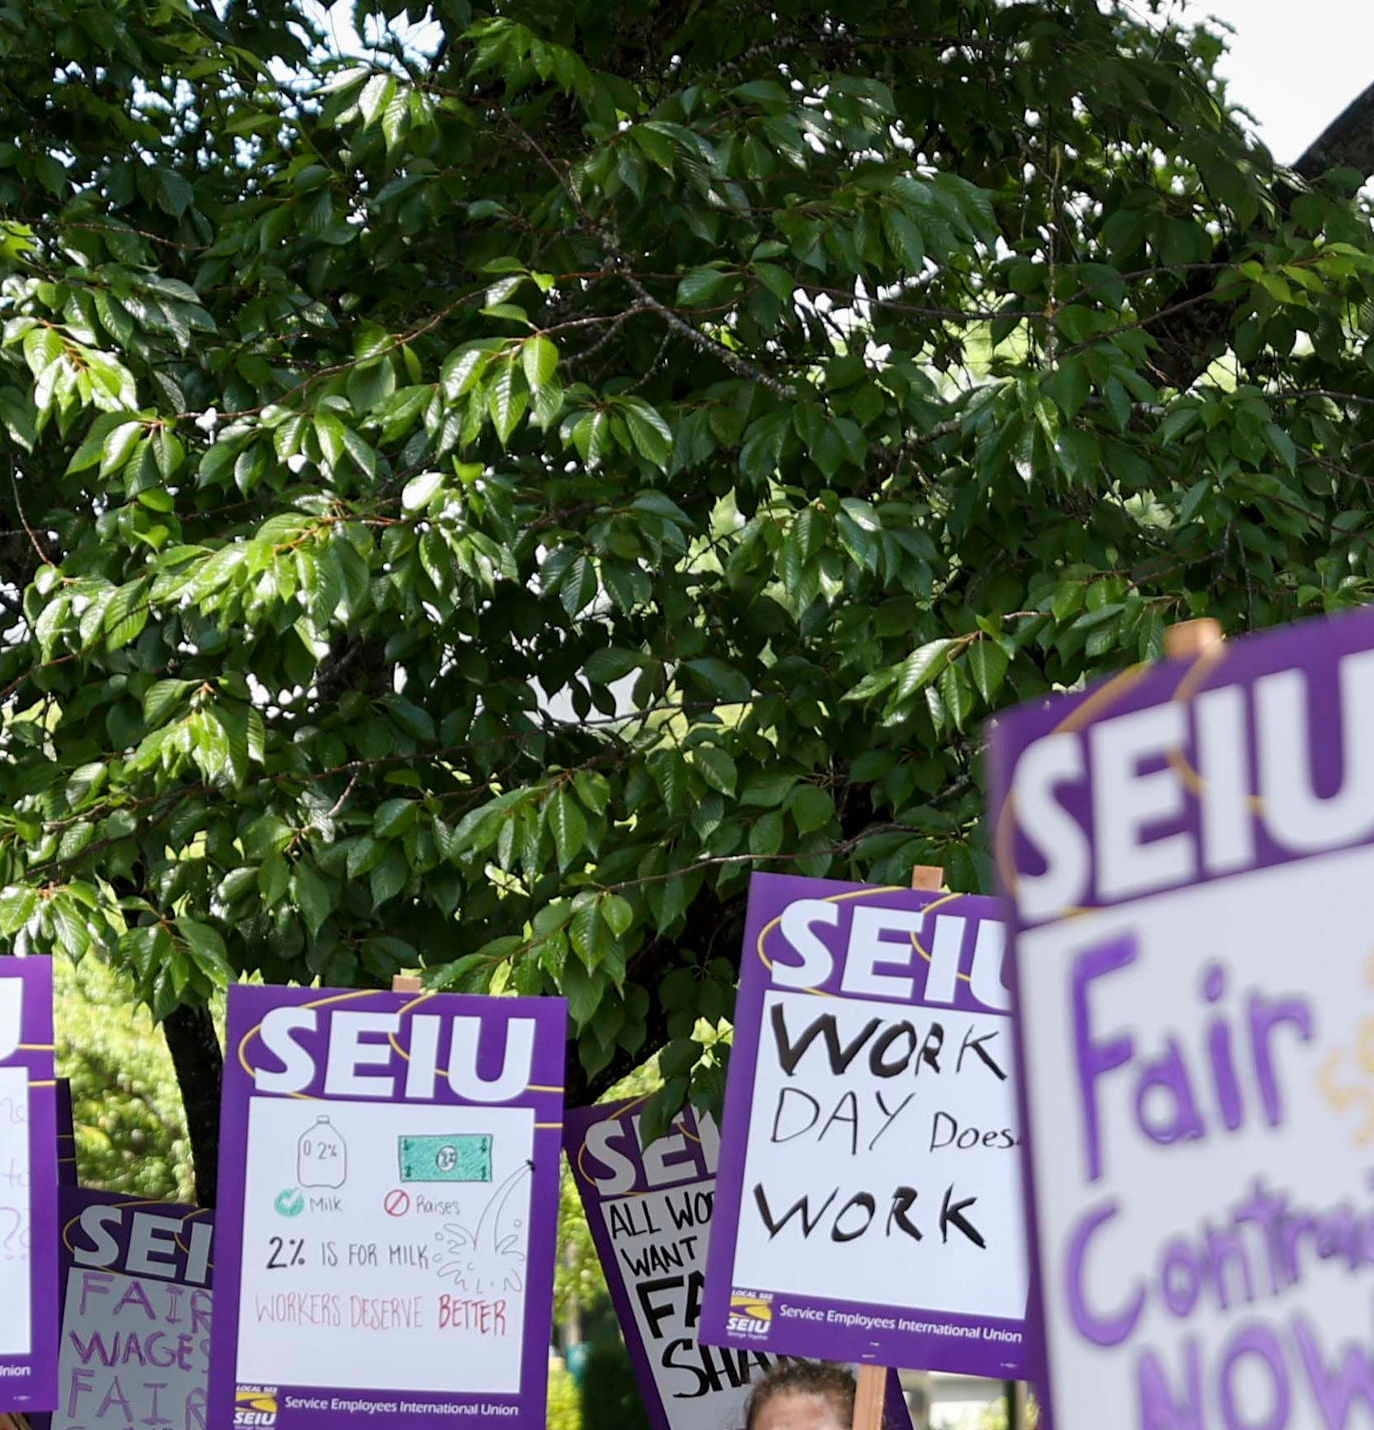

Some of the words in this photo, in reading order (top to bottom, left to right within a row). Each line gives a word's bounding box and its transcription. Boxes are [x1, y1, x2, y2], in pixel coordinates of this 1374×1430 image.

[255, 1006, 537, 1102] SEIU
[770, 1002, 1007, 1080] WORK
[1071, 930, 1314, 1183] Fair
[771, 1086, 915, 1156] DAY
[930, 1110, 1021, 1152] Does
[585, 1104, 721, 1196] SEI
[416, 1194, 461, 1216] Raises
[609, 1200, 662, 1240] ALL
[753, 1182, 986, 1249] WORK
[74, 1204, 213, 1284] SEI
[266, 1236, 306, 1270] 2%
[321, 1241, 338, 1268] IS
[348, 1243, 378, 1267] FOR
[388, 1244, 430, 1270] MILK
[621, 1236, 699, 1278] WANT
[255, 1292, 341, 1328] WORKERS
[350, 1294, 424, 1331] DESERVE
[437, 1293, 506, 1337] BETTER
[726, 1318, 770, 1333] SEIU
[779, 1304, 825, 1320] Service
[826, 1310, 896, 1330] Employees
[898, 1317, 980, 1339] International
[982, 1328, 1022, 1344] Union
[233, 1412, 277, 1425] SEIU
[284, 1396, 327, 1410] Service
[330, 1398, 398, 1415] Employees
[399, 1401, 479, 1416] International
[481, 1403, 519, 1417] Union
